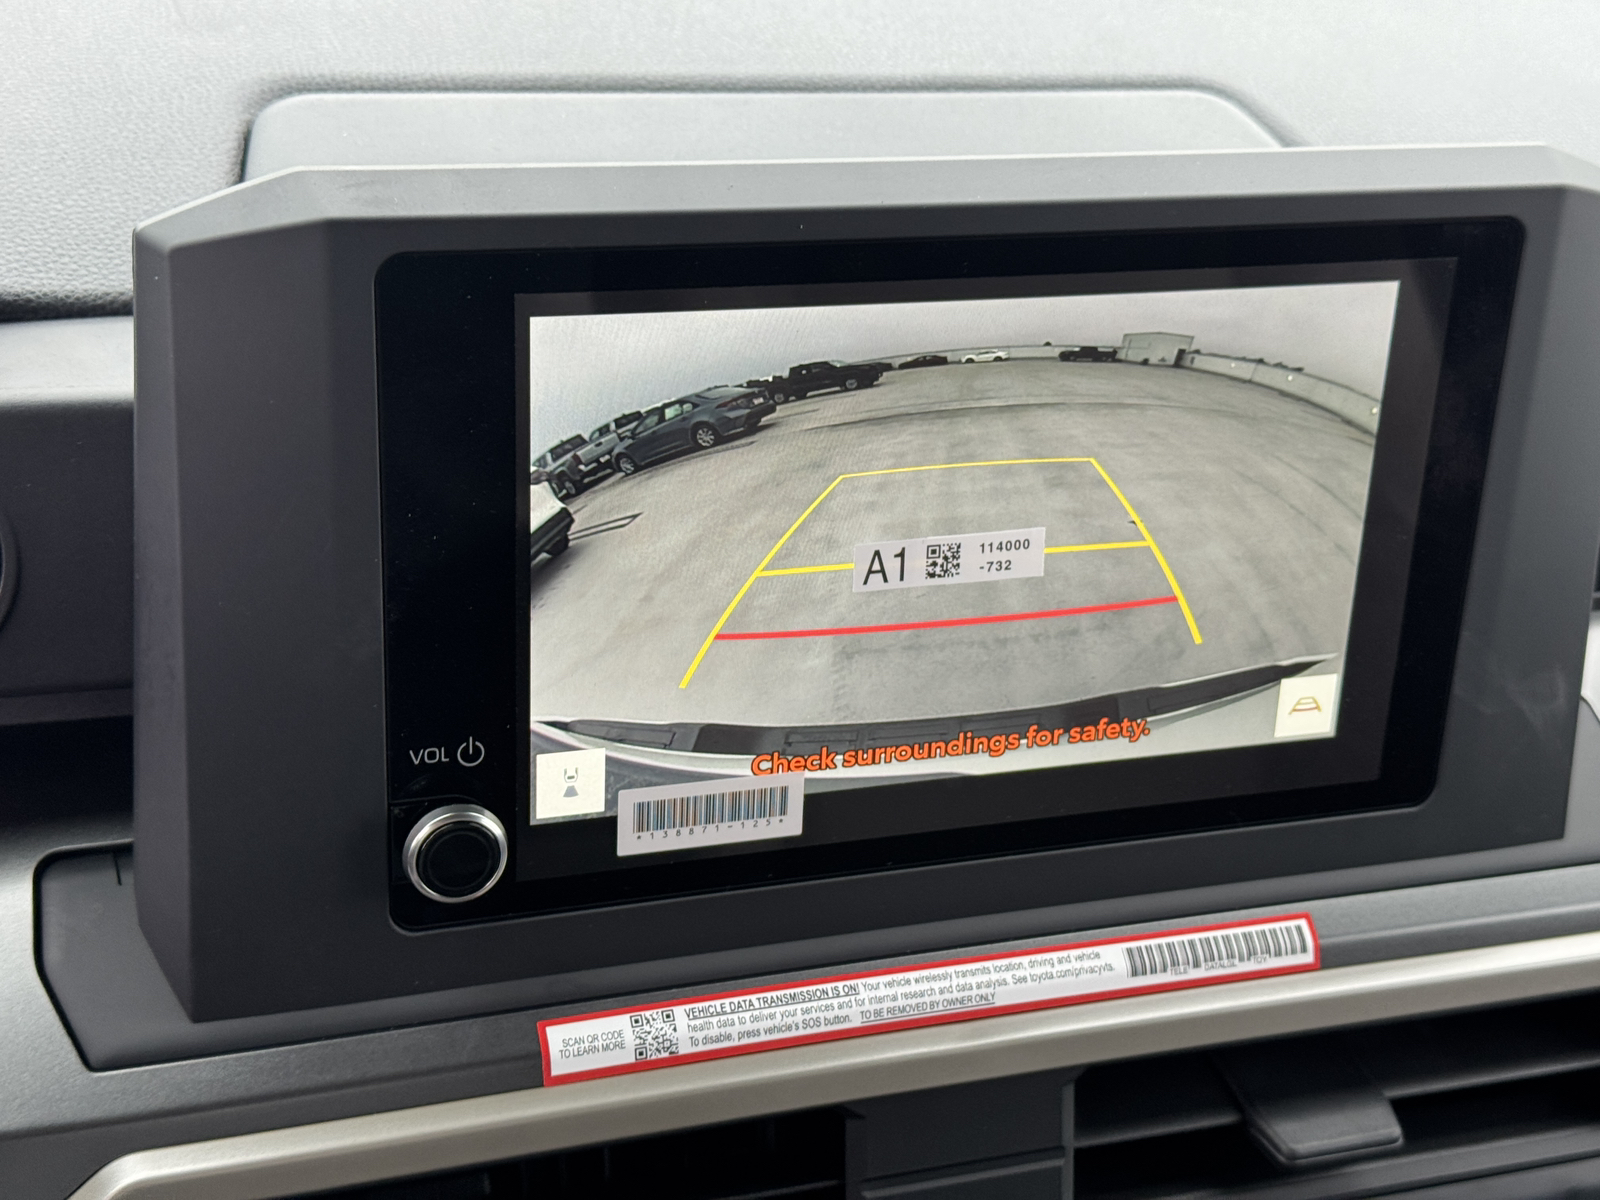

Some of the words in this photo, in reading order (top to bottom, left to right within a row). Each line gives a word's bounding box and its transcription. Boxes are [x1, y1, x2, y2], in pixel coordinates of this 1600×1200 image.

[979, 538, 1030, 553] 114000
[862, 546, 906, 586] A1
[979, 559, 1012, 573] -732
[409, 746, 450, 765] VOL
[751, 746, 837, 776] Check
[841, 731, 1021, 769] surroundings
[1026, 724, 1064, 749] for
[1067, 716, 1151, 745] safety.
[684, 1002, 727, 1020] VEHICLE
[729, 998, 755, 1013] DATA
[756, 987, 829, 1008] TRANSMISSION
[831, 985, 841, 997] IS
[843, 983, 860, 995] ON!
[861, 981, 881, 993] Your
[883, 975, 912, 988] vehicle
[912, 970, 953, 985] wirelessly
[954, 964, 991, 979] transmits
[992, 961, 1027, 974] location,
[1028, 956, 1055, 969] driving
[1056, 953, 1071, 965] and
[1072, 949, 1101, 962] vehicle
[687, 1019, 714, 1034] health
[716, 1016, 736, 1029] data
[738, 1014, 746, 1025] to
[749, 1010, 778, 1024] deliver
[779, 1008, 798, 1022] your
[800, 1001, 835, 1016] services
[837, 998, 853, 1010] and
[855, 995, 866, 1008] for
[868, 990, 899, 1005] internal
[900, 986, 935, 1001] research
[938, 984, 953, 996] and
[955, 980, 973, 993] data
[975, 976, 1010, 990] analysis.
[1011, 973, 1028, 985] See
[689, 1036, 700, 1048] To
[702, 1030, 735, 1046] disable,
[737, 1027, 761, 1042] press
[763, 1021, 800, 1037] vehicle's
[801, 1017, 822, 1030] SOS
[823, 1013, 853, 1027] button.
[860, 1009, 872, 1021] TO
[873, 1006, 885, 1018] BE
[886, 1001, 928, 1017] REMOVED
[929, 999, 940, 1011] BY
[942, 995, 973, 1008] OWNER
[975, 992, 996, 1004] ONLY
[559, 1048, 571, 1059] TO
[572, 1043, 599, 1058] LEARN
[601, 1039, 626, 1052] MORE
[562, 1036, 585, 1048] SCAN
[600, 1029, 625, 1041] CODE
